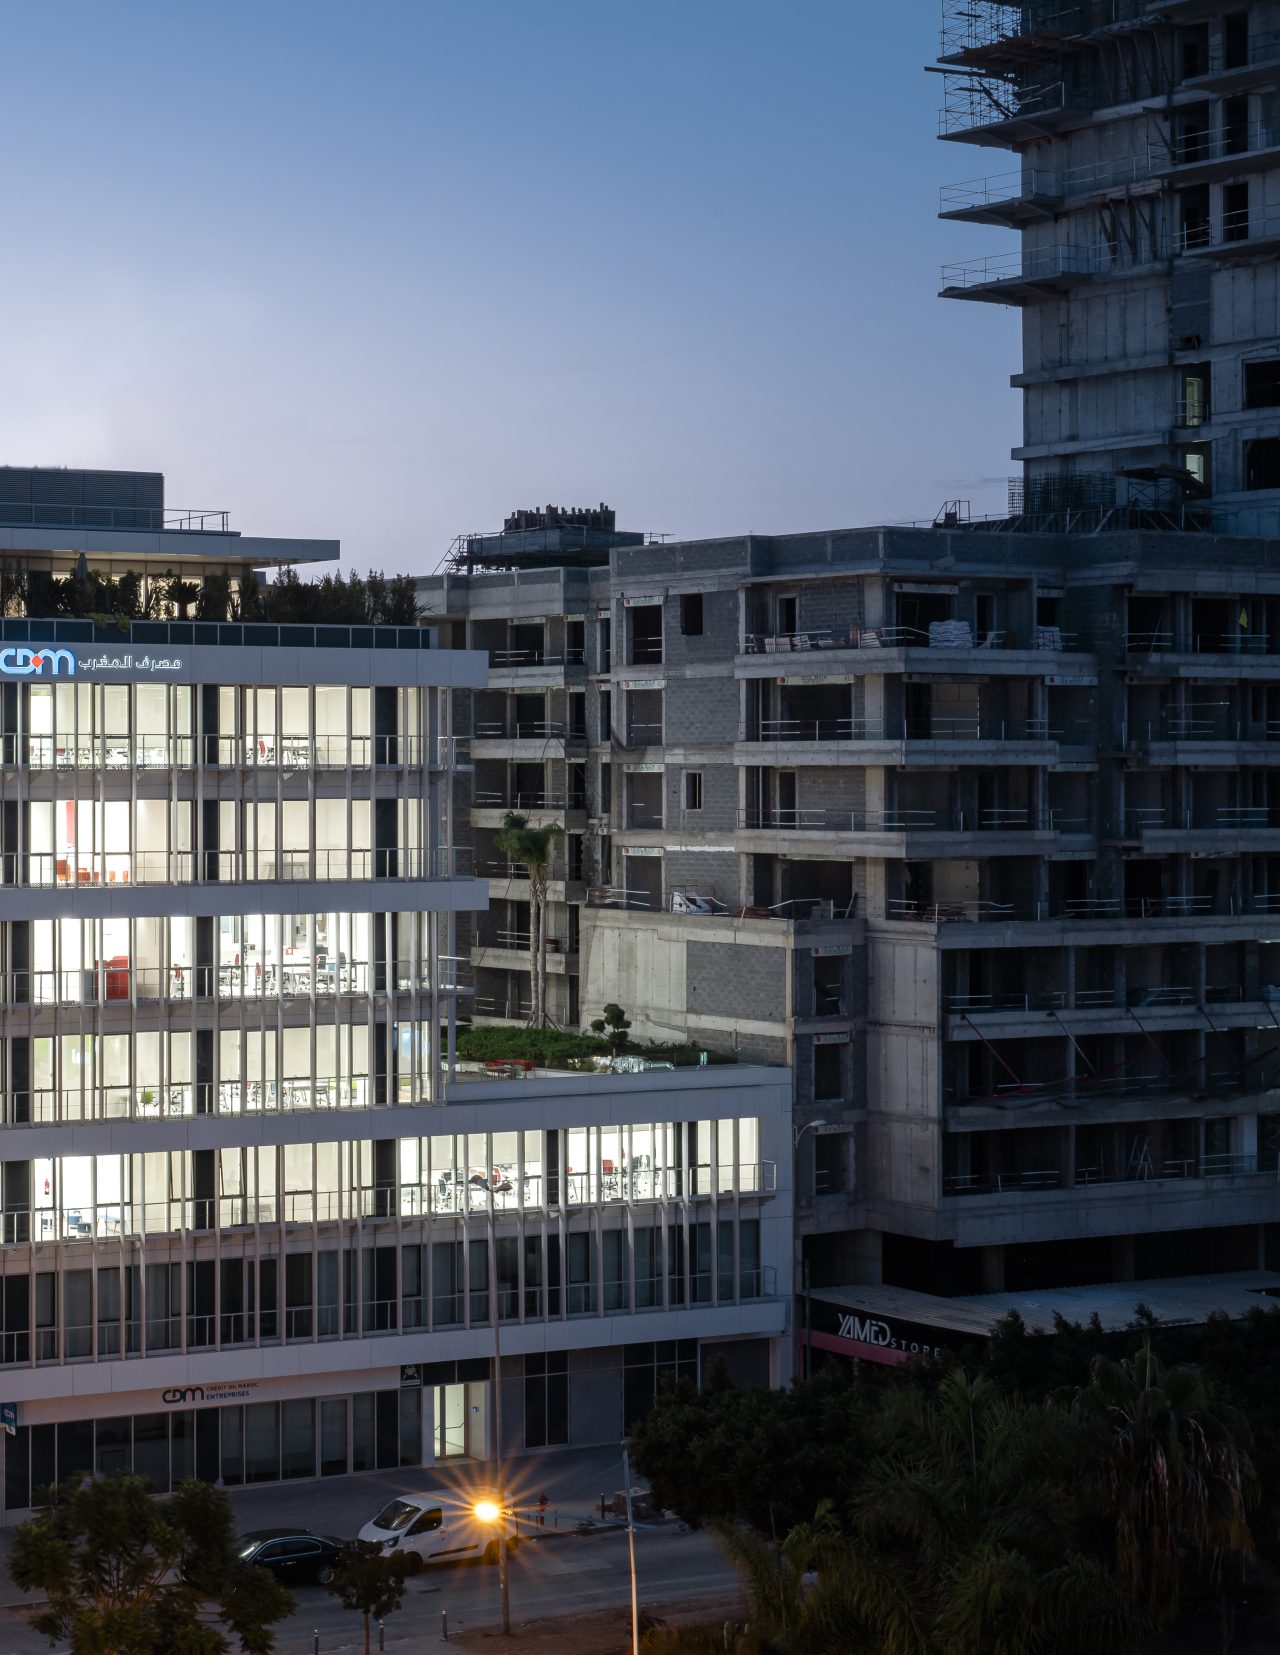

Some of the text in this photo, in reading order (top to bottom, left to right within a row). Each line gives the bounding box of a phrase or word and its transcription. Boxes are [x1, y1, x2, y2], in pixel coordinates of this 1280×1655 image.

[78, 654, 182, 671] مصرف المغرب
[207, 1390, 250, 1400] ENTREPRISES
